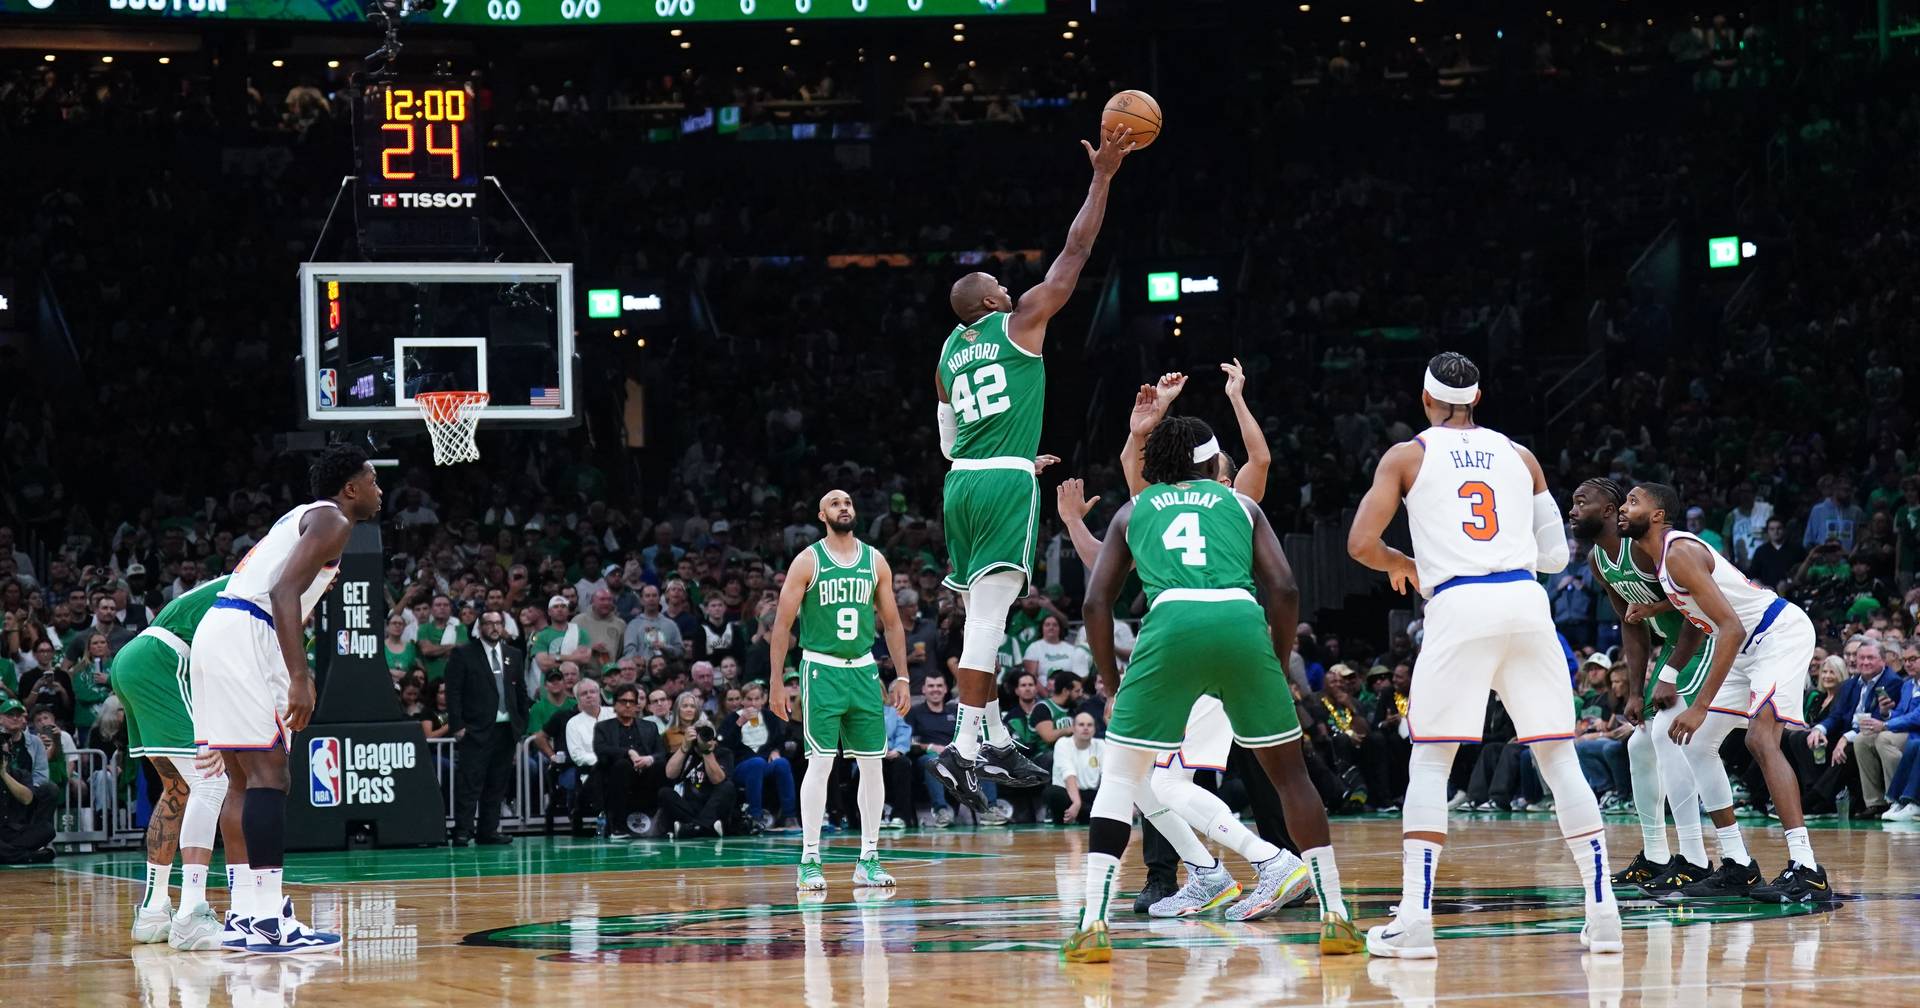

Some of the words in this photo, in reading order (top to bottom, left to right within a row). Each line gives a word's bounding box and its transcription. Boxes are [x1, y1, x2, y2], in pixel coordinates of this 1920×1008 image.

[385, 89, 465, 121] 12:00
[381, 123, 461, 180] 24
[398, 192, 477, 208] TISSOT
[947, 342, 1000, 374] HORFORD
[951, 362, 1012, 424] 42
[1450, 449, 1495, 470] HART
[1149, 491, 1223, 512] HOLIDAY
[1457, 480, 1500, 542] 3
[1161, 511, 1208, 566] 4
[342, 581, 370, 605] GET
[818, 577, 873, 607] BOSTON
[342, 605, 371, 629] THE
[836, 607, 859, 640] 9
[350, 630, 377, 659] App
[344, 737, 416, 776] League
[314, 790, 330, 803] NBA
[346, 771, 395, 805] Pass
